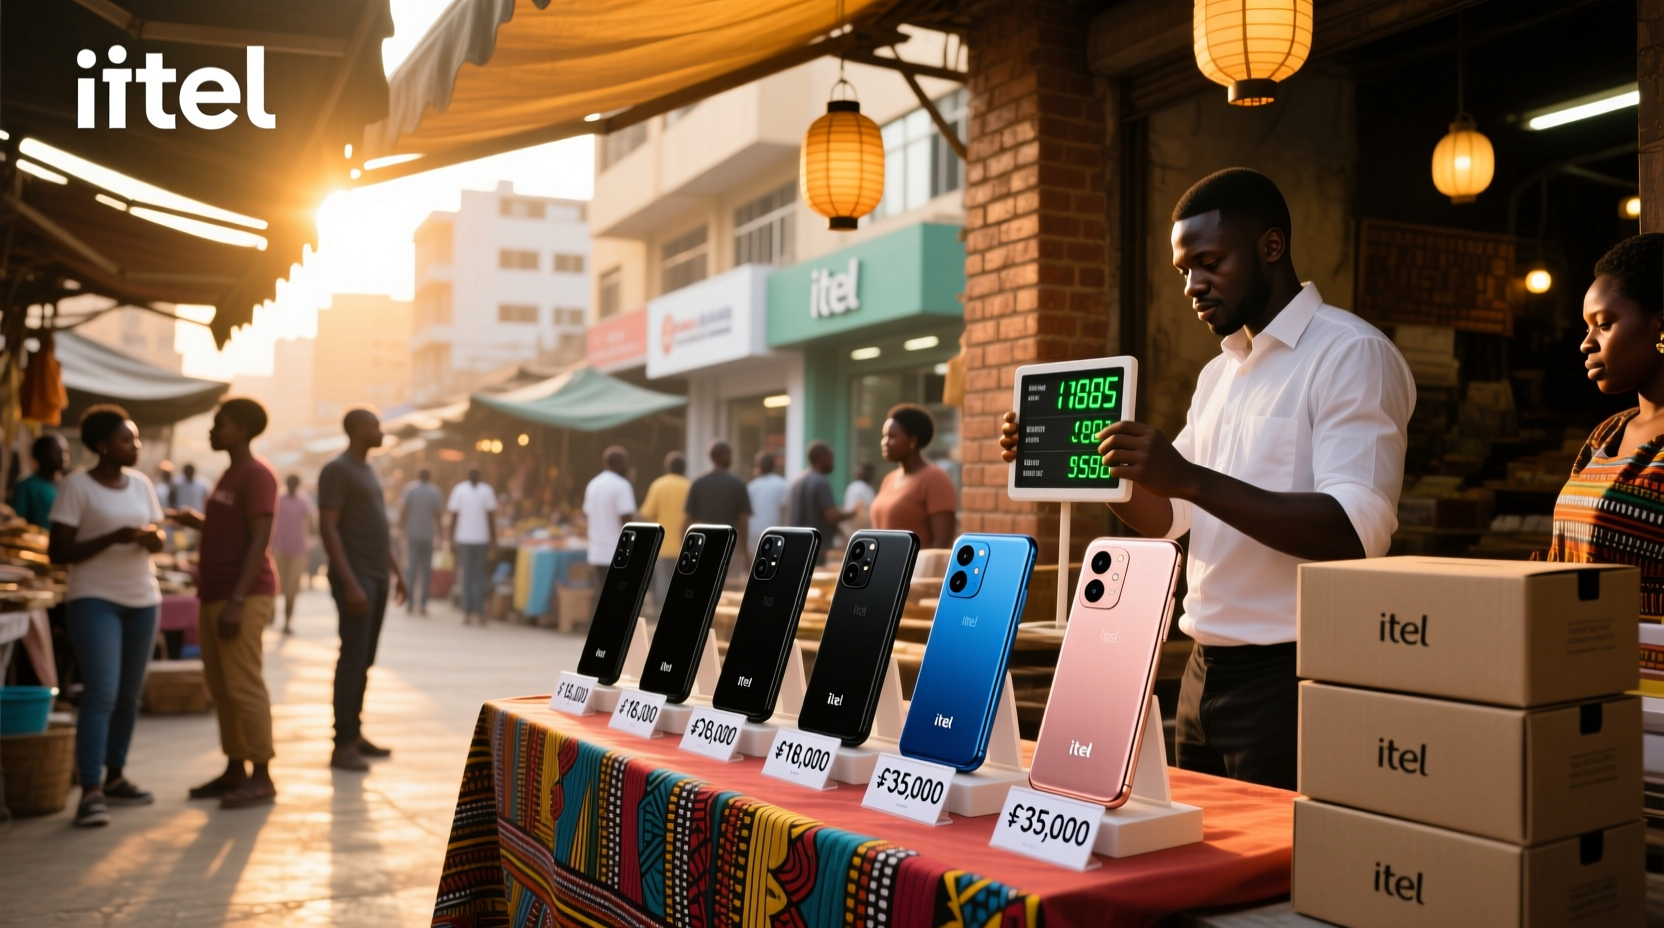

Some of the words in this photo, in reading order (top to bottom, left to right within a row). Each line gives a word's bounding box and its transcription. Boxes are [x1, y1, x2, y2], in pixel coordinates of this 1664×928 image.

[810, 256, 860, 319] itel
[1379, 611, 1430, 648] itel
[934, 712, 954, 730] itel
[1069, 739, 1093, 759] itel
[1377, 737, 1429, 777] itel
[1373, 861, 1425, 905] itel
